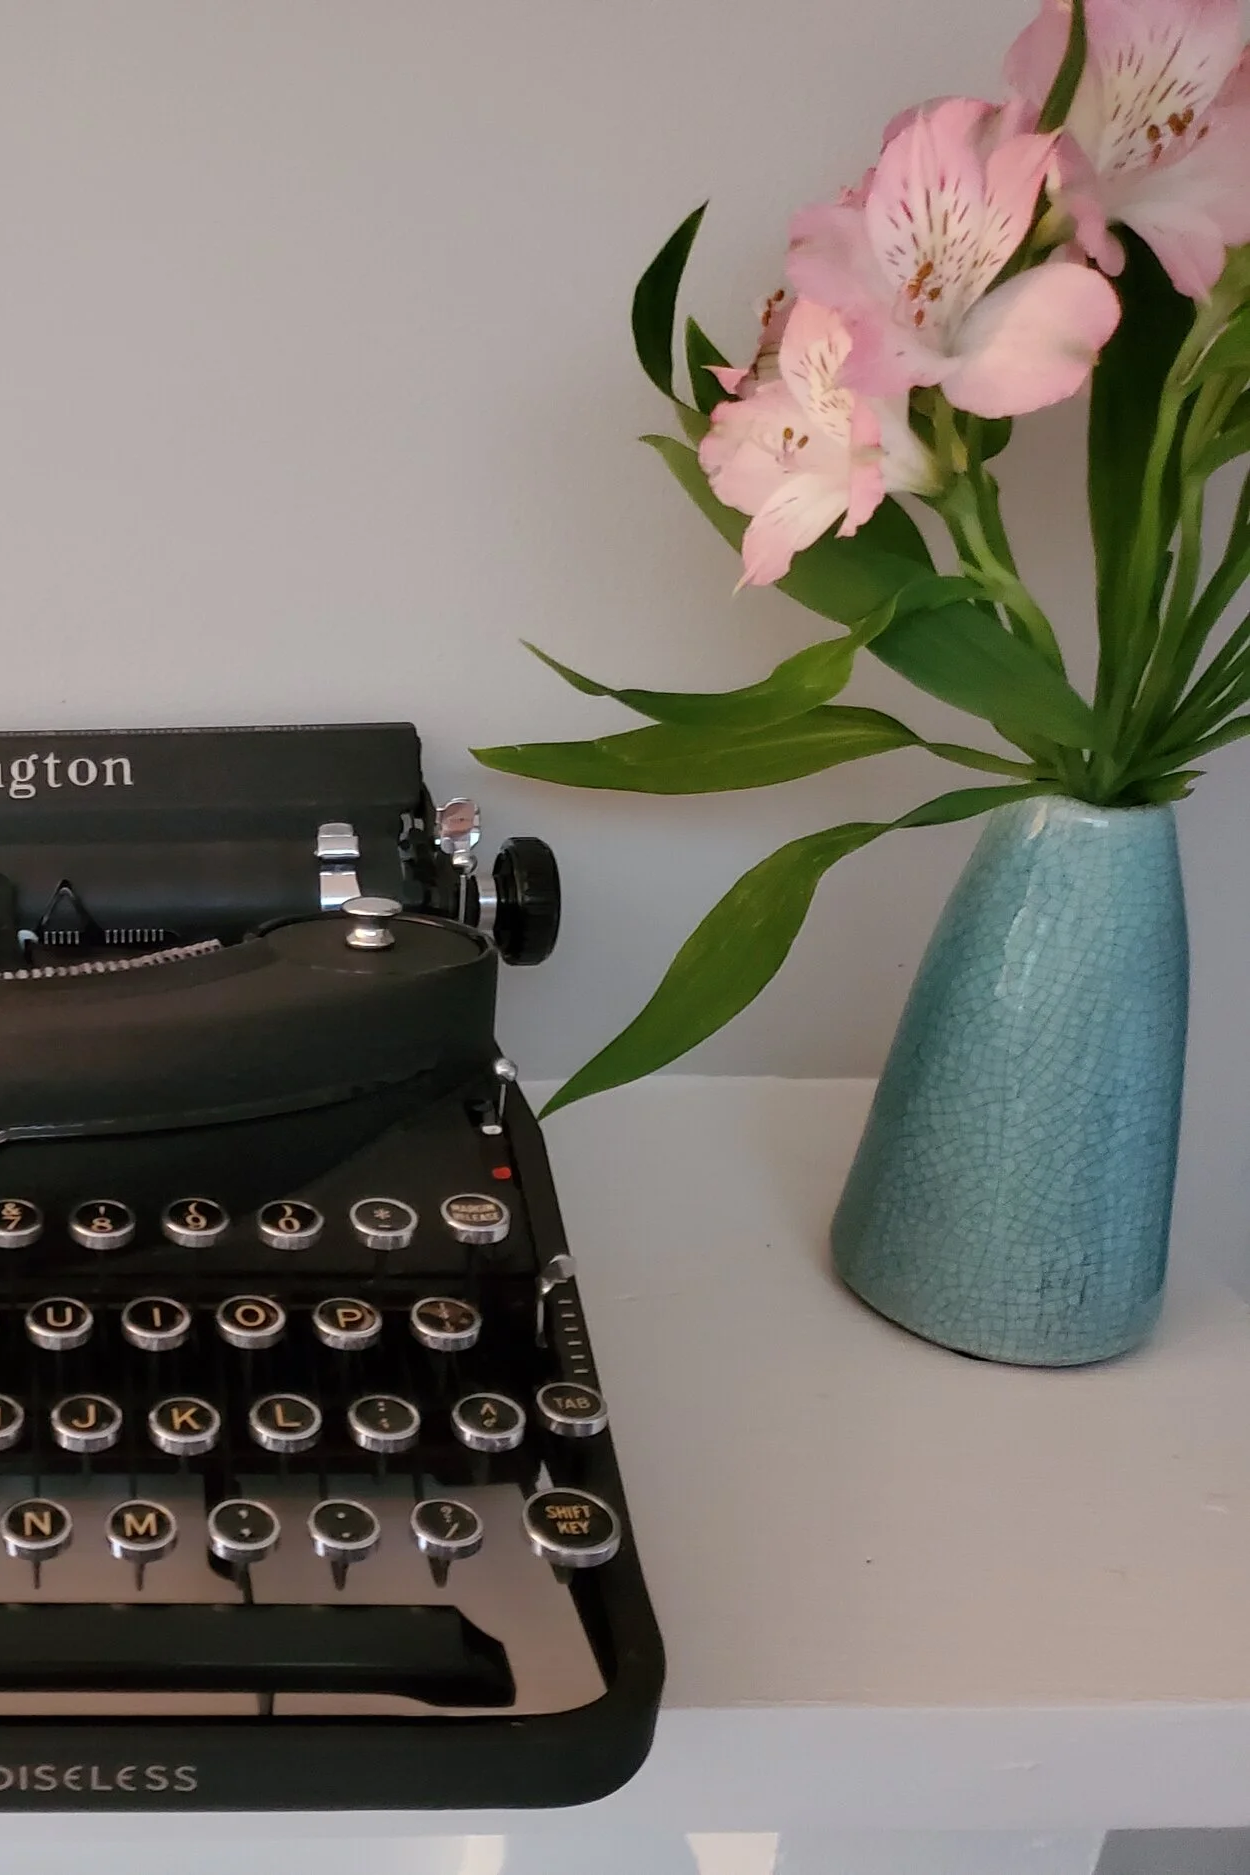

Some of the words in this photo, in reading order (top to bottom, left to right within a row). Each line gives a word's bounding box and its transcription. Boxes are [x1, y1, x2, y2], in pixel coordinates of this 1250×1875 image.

[2, 1214, 24, 1230] 7
[91, 1217, 114, 1232] 8
[185, 1213, 208, 1230] 9
[46, 1307, 73, 1327] U
[152, 1307, 162, 1328] I
[234, 1304, 267, 1327] O
[336, 1308, 364, 1328] P
[553, 1397, 591, 1410] TAB
[71, 1404, 96, 1428] J
[171, 1407, 200, 1430] K
[273, 1404, 302, 1427] L
[544, 1504, 591, 1520] SHIFT
[24, 1511, 52, 1536] N
[124, 1512, 156, 1536] M
[557, 1521, 590, 1535] KEY
